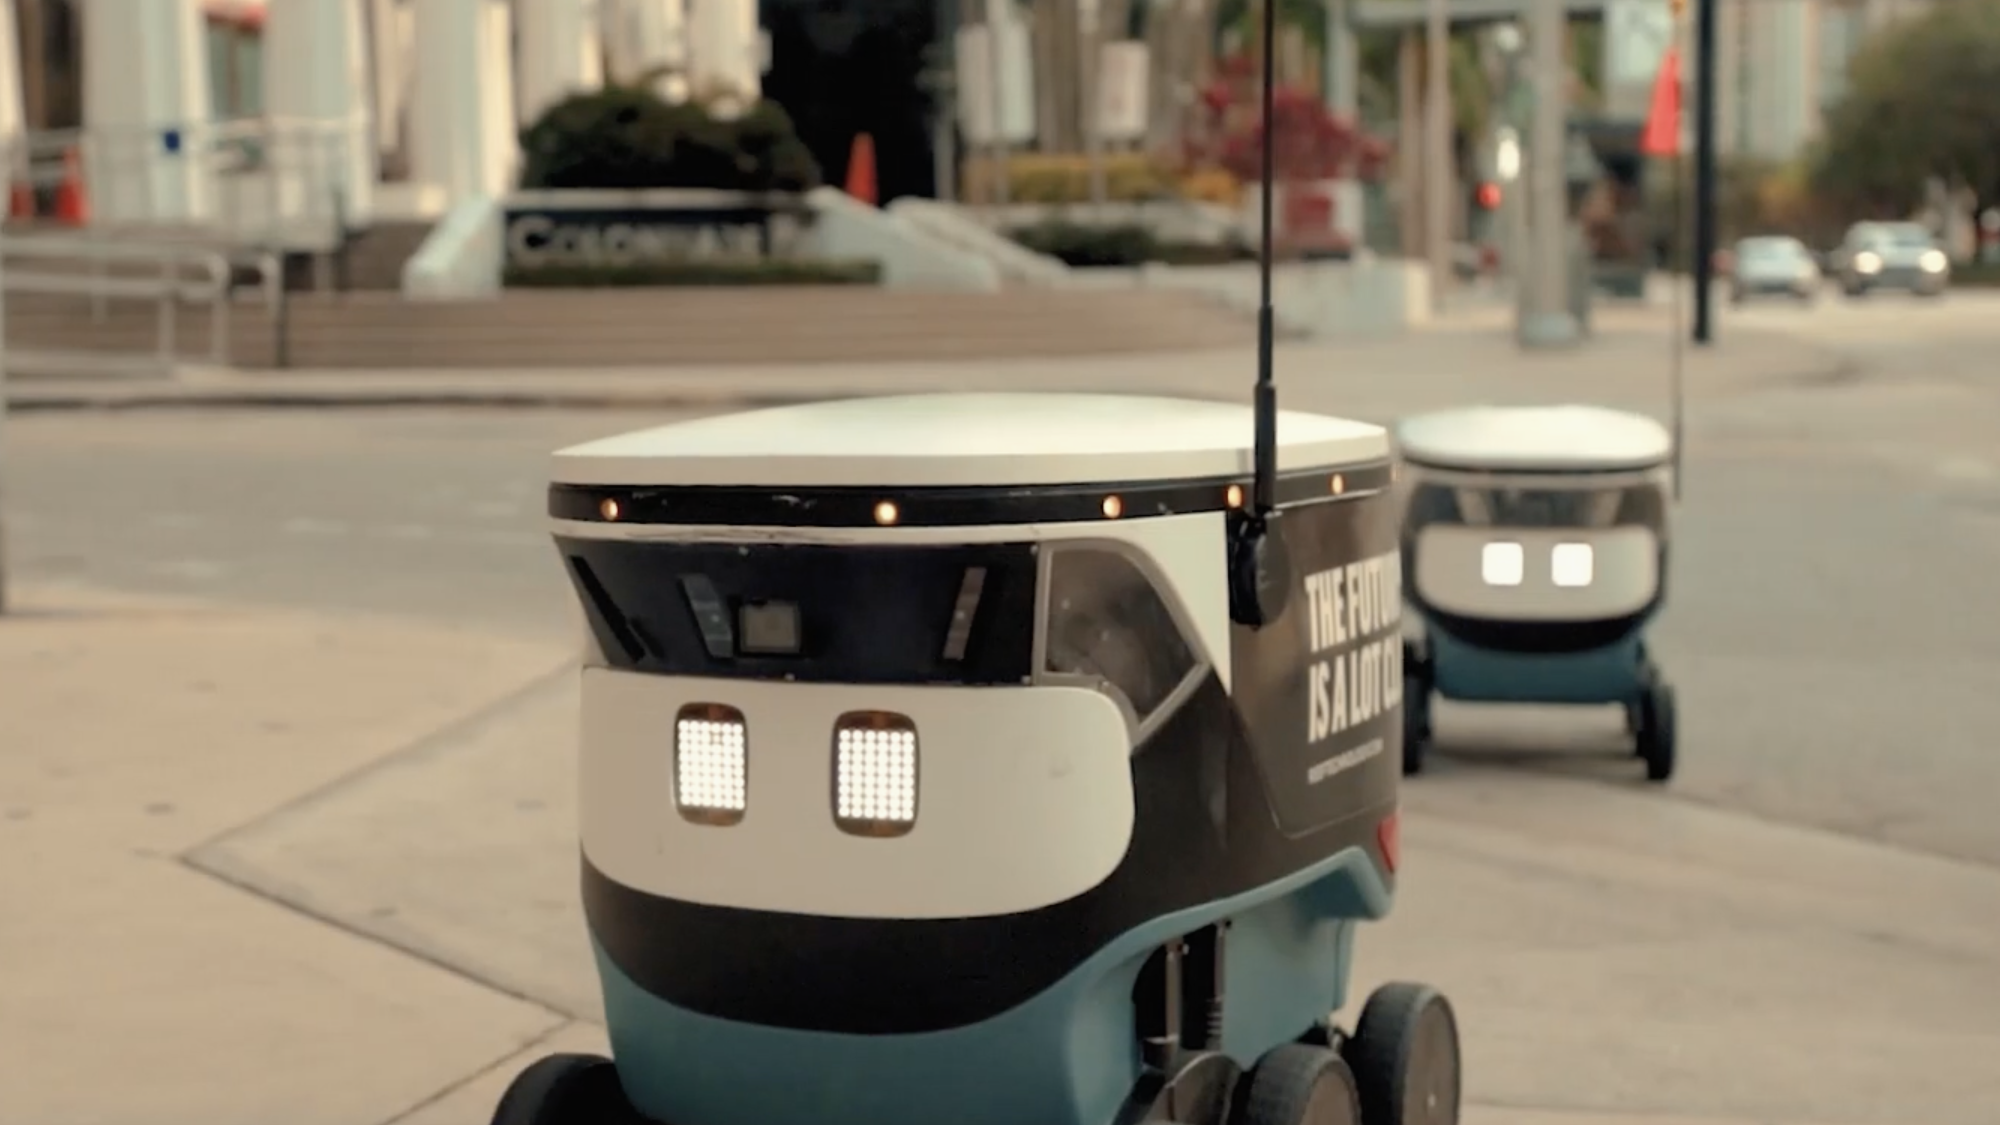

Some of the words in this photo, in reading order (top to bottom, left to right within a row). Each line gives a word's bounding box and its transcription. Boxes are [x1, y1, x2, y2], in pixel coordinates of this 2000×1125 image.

[1304, 567, 1346, 653] THE
[1308, 662, 1330, 743] IS
[1331, 656, 1348, 734] A
[1351, 642, 1382, 727] LOT
